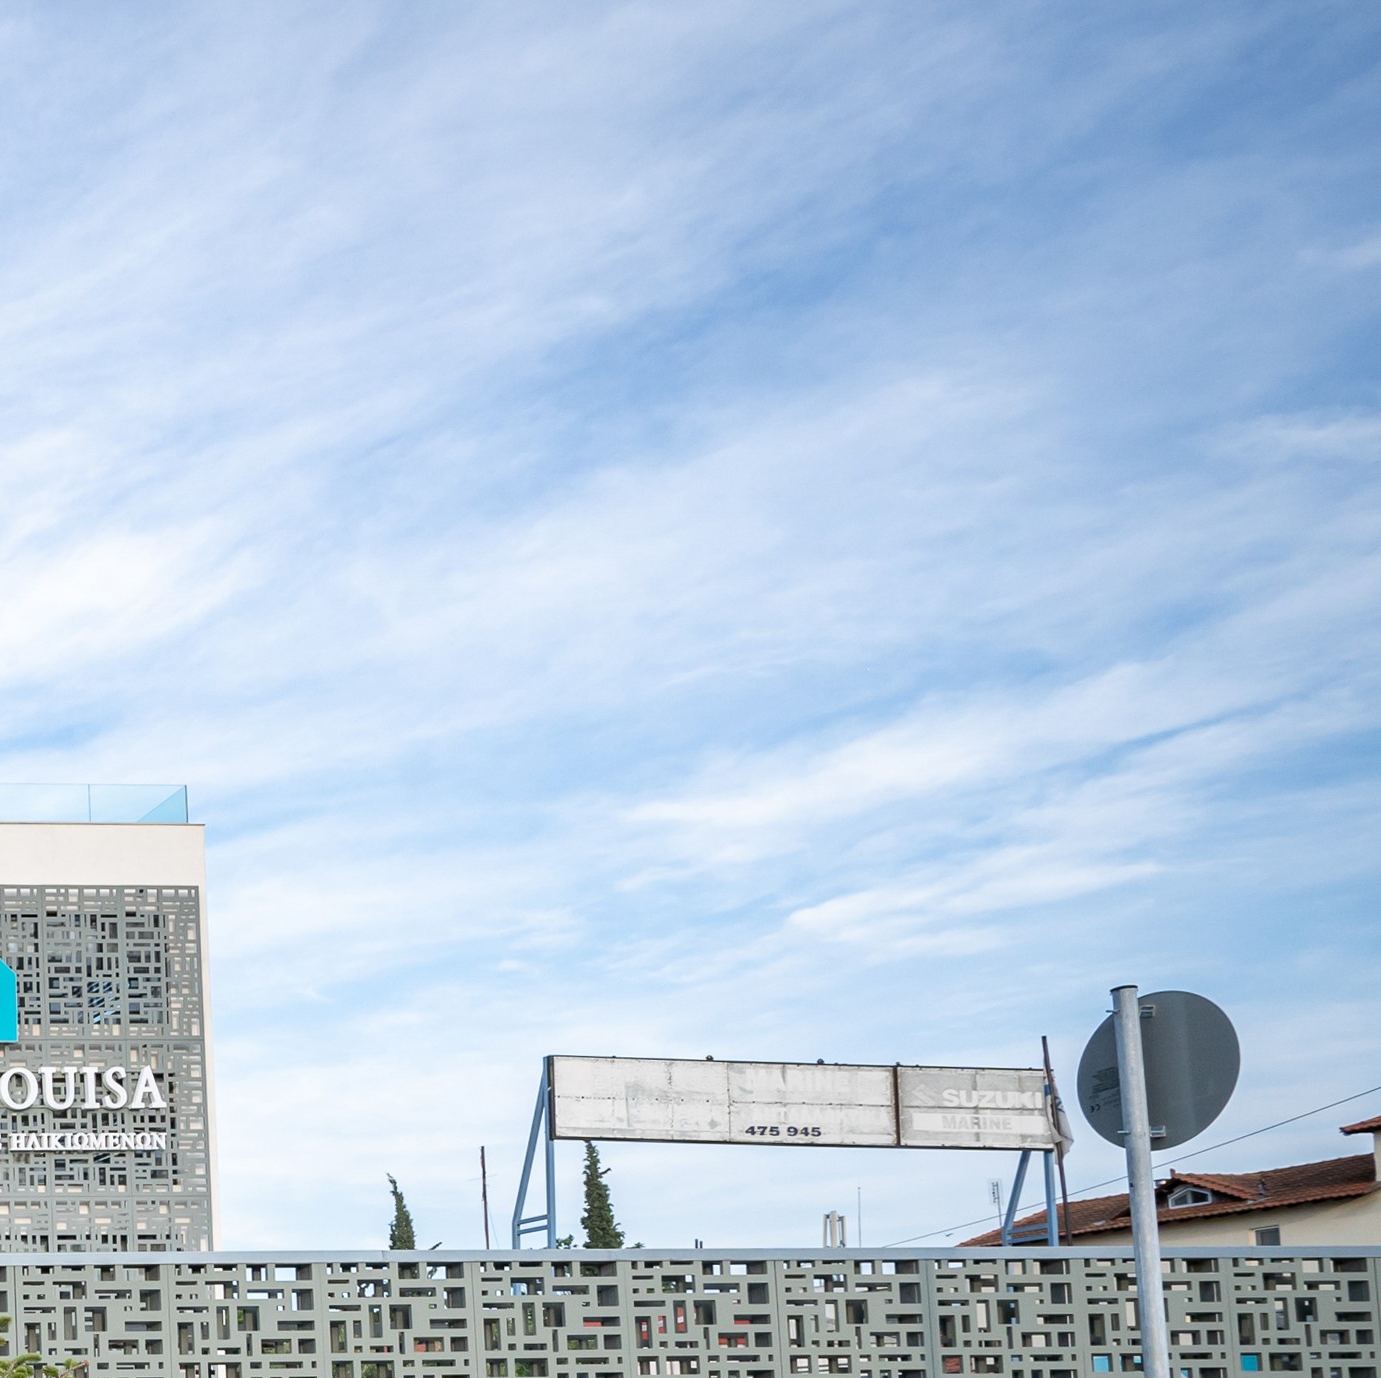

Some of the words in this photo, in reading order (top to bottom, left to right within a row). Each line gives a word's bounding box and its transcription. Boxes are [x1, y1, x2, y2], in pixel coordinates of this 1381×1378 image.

[942, 1088, 1043, 1109] SUZUKI
[745, 1125, 780, 1137] 475
[786, 1126, 822, 1137] 945
[942, 1114, 1013, 1131] MARINE
[9, 1132, 168, 1151] ΗΛΙΚΙΩΜΕΝΩΝ
